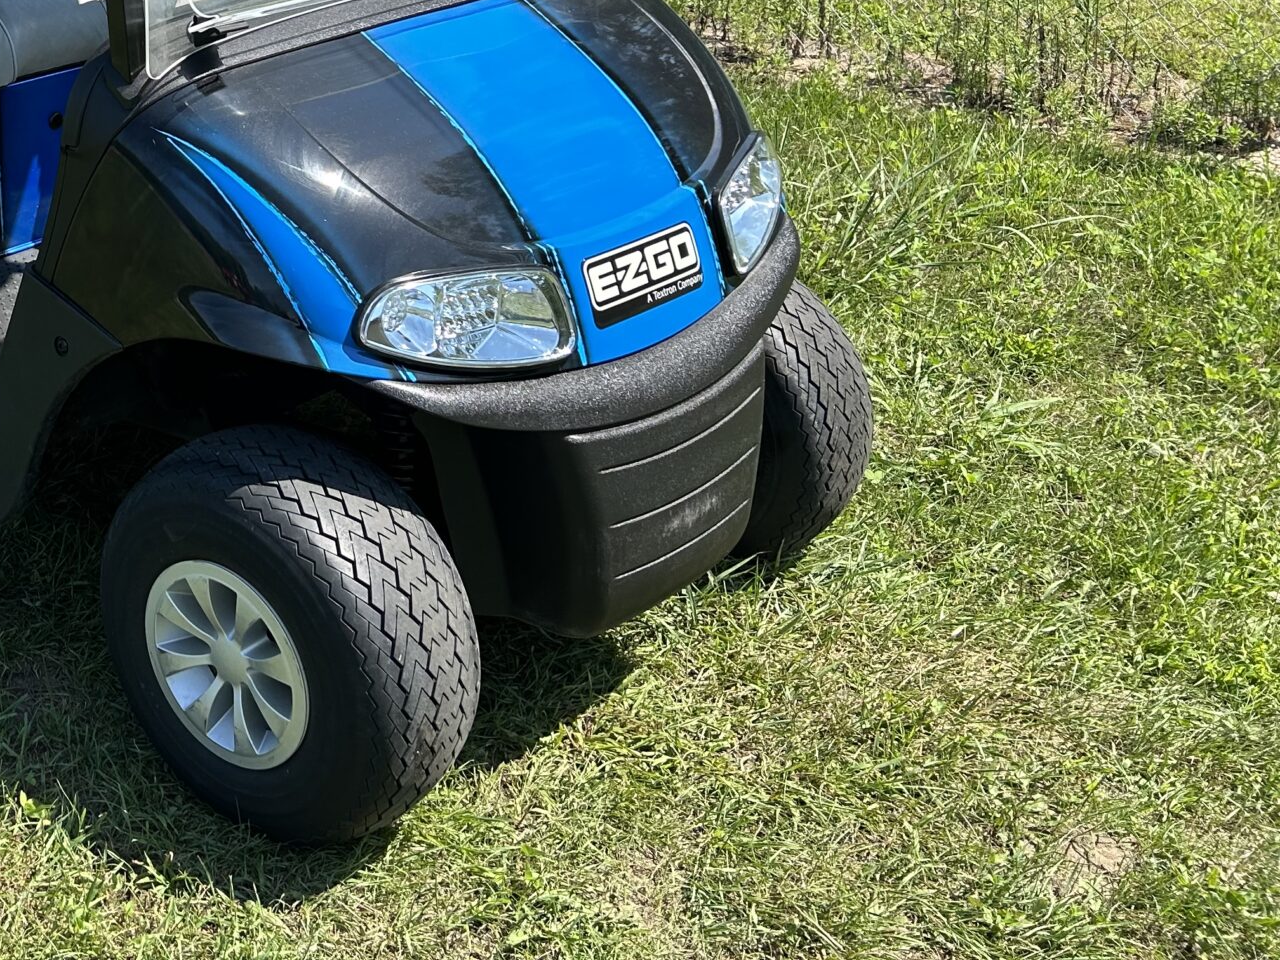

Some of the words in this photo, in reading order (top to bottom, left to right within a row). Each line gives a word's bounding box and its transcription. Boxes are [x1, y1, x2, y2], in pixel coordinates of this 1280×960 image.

[647, 293, 653, 303] A
[653, 285, 677, 300] Textron
[677, 273, 704, 290] Company
